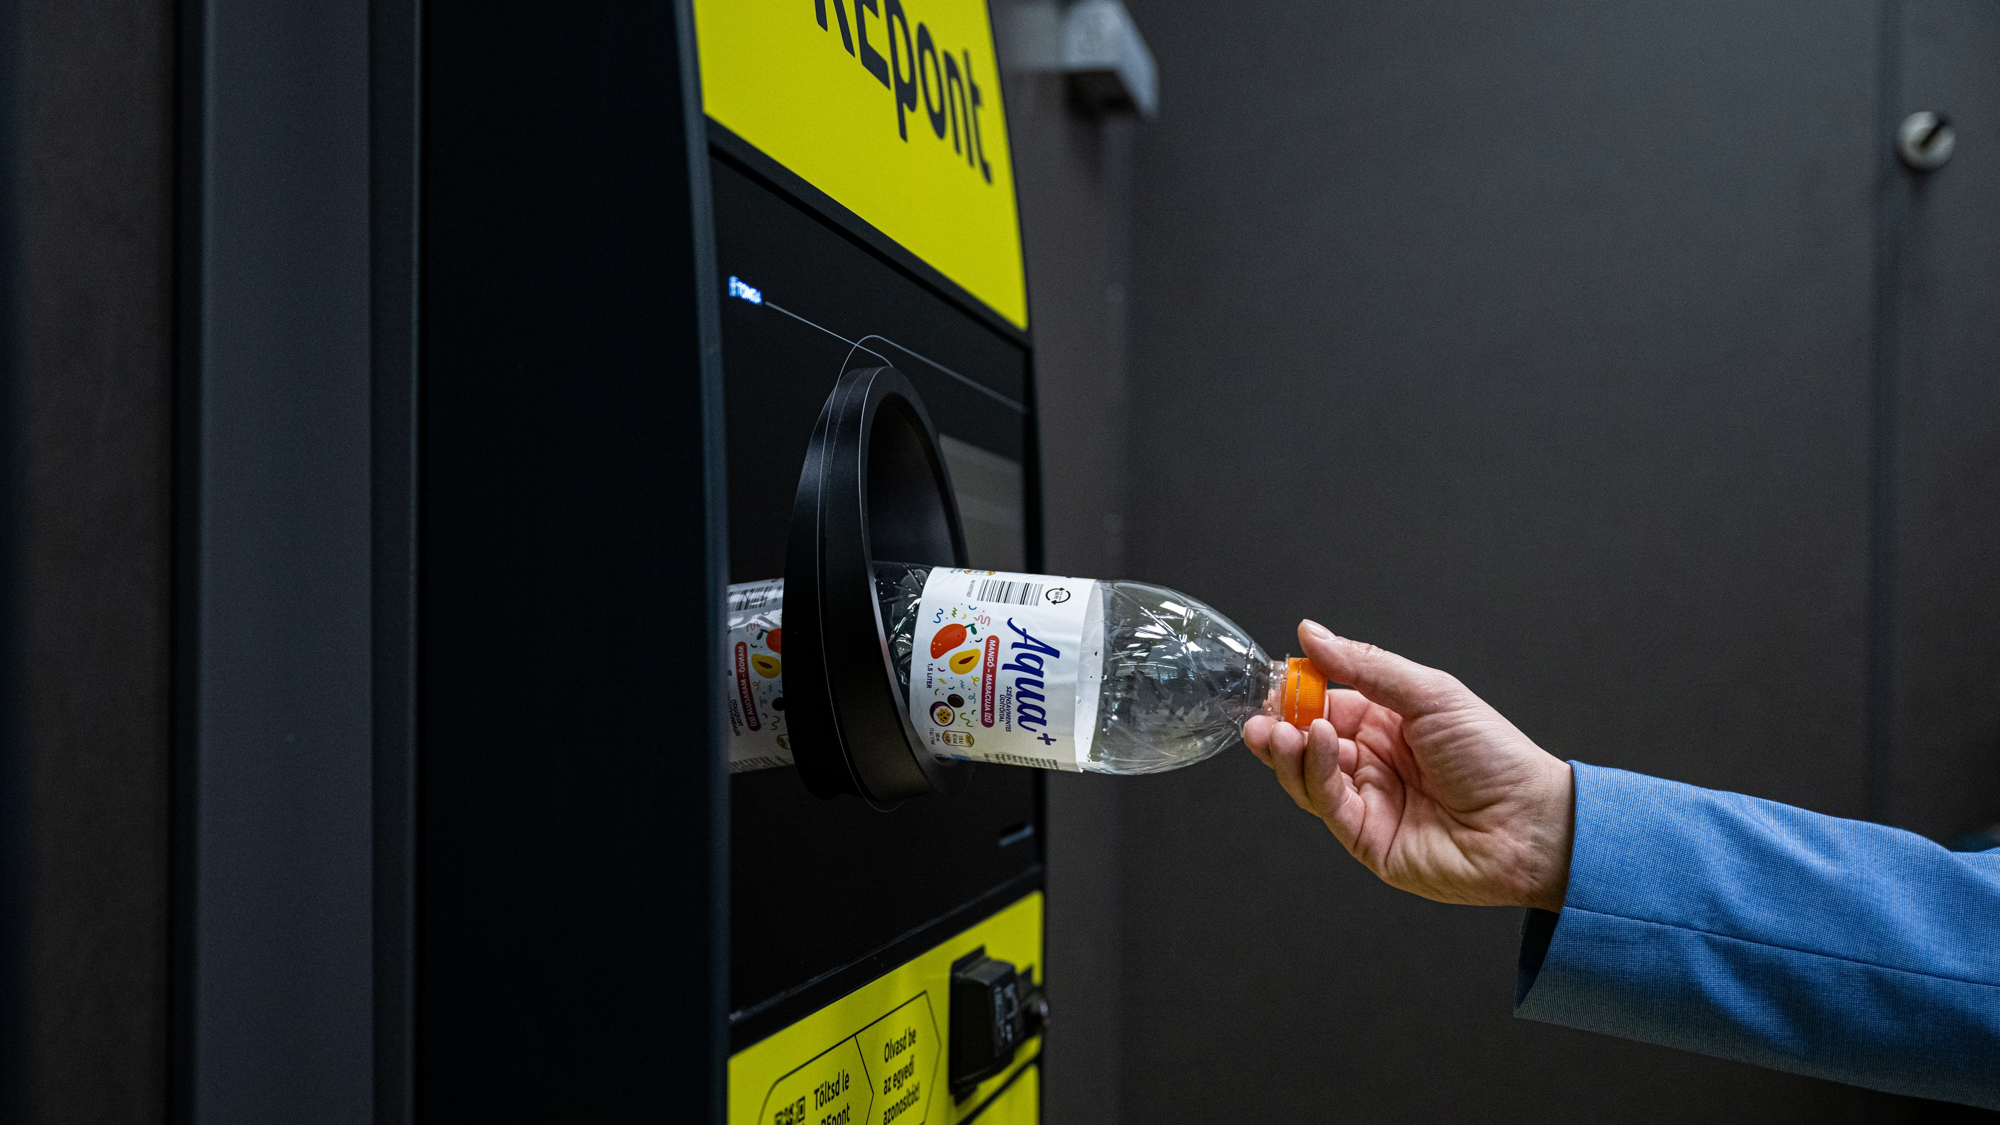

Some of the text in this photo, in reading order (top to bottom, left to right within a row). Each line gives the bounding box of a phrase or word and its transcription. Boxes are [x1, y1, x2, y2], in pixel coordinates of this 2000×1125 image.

[814, 0, 992, 185] Epont
[926, 662, 934, 672] 1,5
[986, 639, 996, 667] MANGÓ
[984, 674, 993, 712] MARACUJA
[884, 1026, 916, 1063] Olvasd be
[814, 1069, 850, 1111] Töltsd le
[883, 1054, 915, 1095] az egyedi
